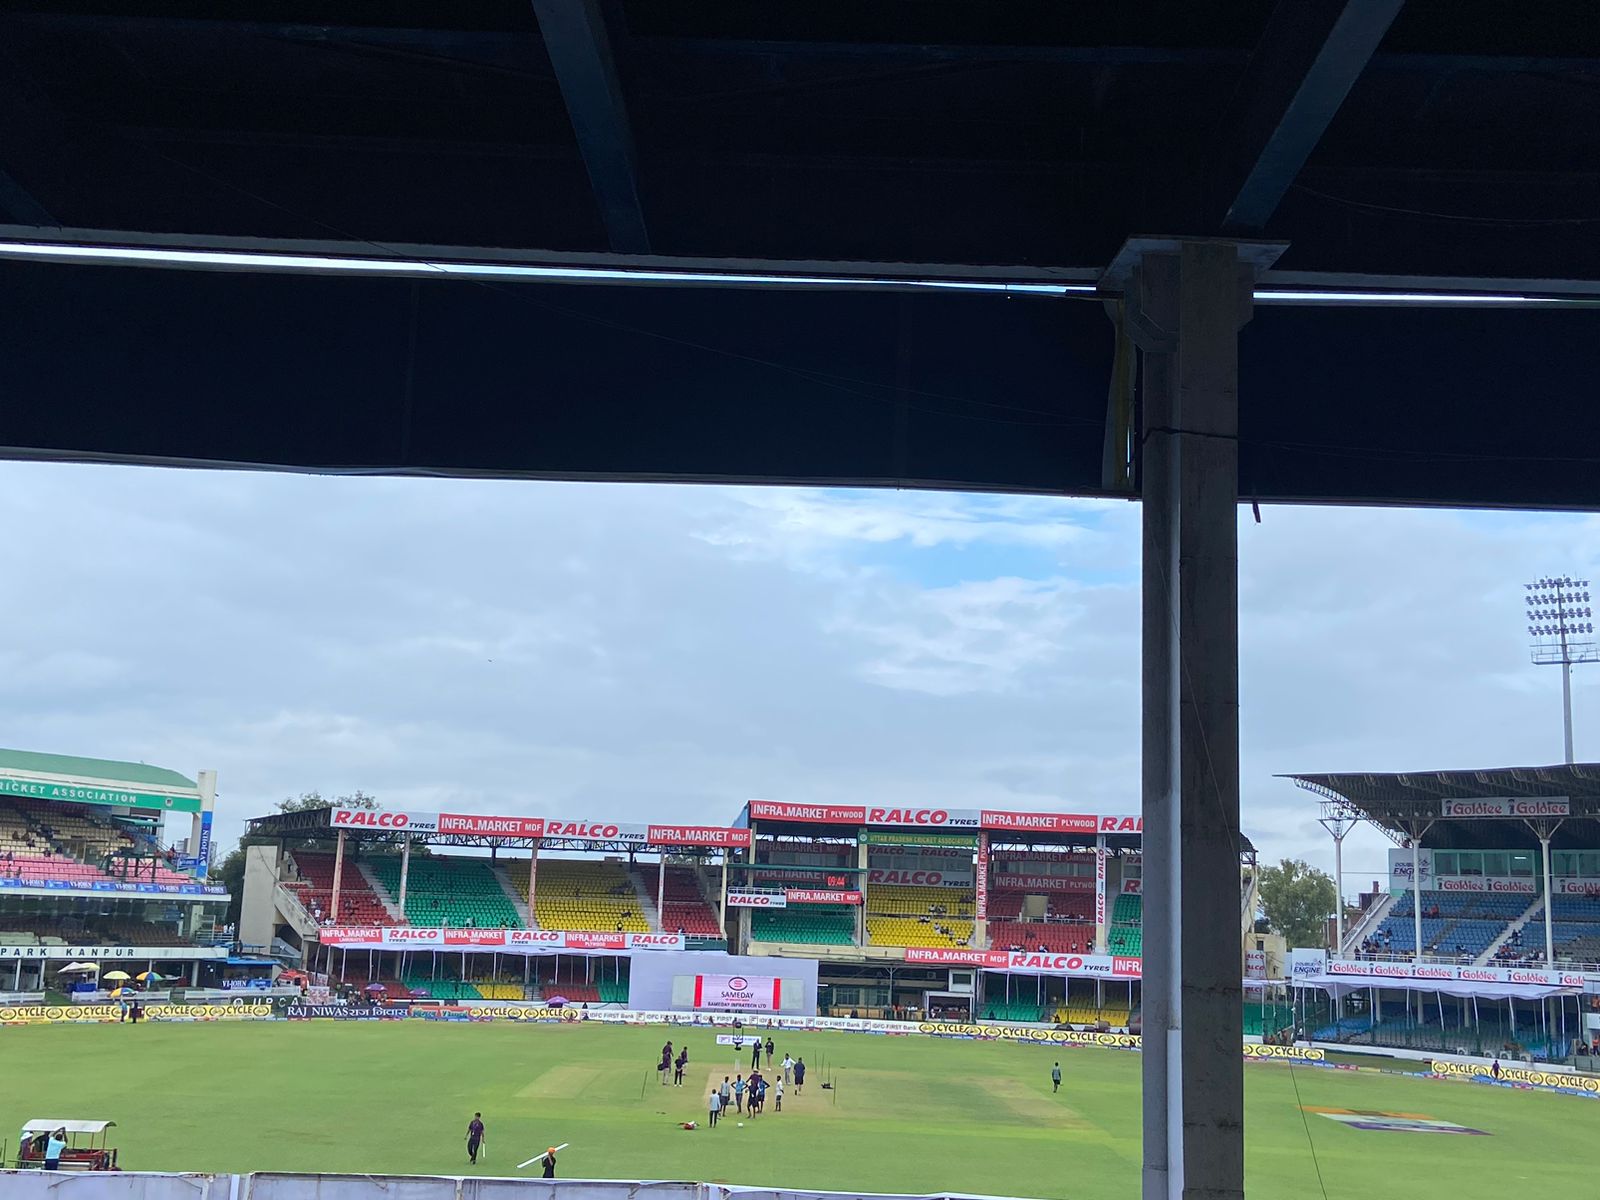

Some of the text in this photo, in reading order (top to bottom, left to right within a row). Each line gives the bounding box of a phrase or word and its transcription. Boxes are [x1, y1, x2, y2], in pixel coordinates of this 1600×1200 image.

[52, 788, 137, 803] ASSOCIATION
[753, 803, 864, 819] INFRA.MARKET PLYWOOD
[1453, 801, 1567, 815] Goldiee Goldiee
[334, 810, 408, 828] RALCO
[869, 808, 978, 826] RALCO TYRES
[983, 814, 1095, 828] INFRA.MARKET PLYWOOD
[441, 817, 542, 832] INFRA.MARKET MDF
[546, 821, 646, 840] RALCO TYRES
[650, 829, 749, 843] INFRA.MARKET MDF
[868, 869, 943, 885] RALCO
[995, 876, 1067, 889] INFRA.MARKET
[1443, 879, 1534, 892] Goldiee Goldiee
[729, 895, 770, 905] RALCO
[788, 891, 845, 901] INFRA.MARKET
[321, 928, 381, 938] INFRA.MARKET
[389, 930, 438, 939] RALCO
[445, 930, 503, 939] INFRA.MARKET
[511, 932, 559, 941] RALCO
[566, 933, 624, 943] INFRA.MARKET
[632, 935, 679, 945] RALCO
[0, 948, 134, 957] PARK KANPUR
[907, 949, 1008, 963] INFRA.MARKET MDF
[1011, 955, 1083, 970] RALCO
[1114, 959, 1142, 972] INFR
[1333, 962, 1368, 974] Goldiee
[1374, 964, 1409, 976] Goldiee
[1416, 966, 1453, 978] Goldiee
[1462, 969, 1497, 980] Goldiee
[1512, 971, 1549, 983] Goldiee
[222, 979, 247, 988] VI-JOHN
[721, 991, 754, 999] SAMEDAY
[18, 1007, 46, 1017] CYCLE
[83, 1006, 110, 1016] CYCLE
[163, 1006, 190, 1015] CYCLE
[226, 1005, 252, 1015] CYCLE
[287, 1006, 348, 1017] RAJ NIWAS
[484, 1007, 508, 1016] CYCLE
[539, 1008, 563, 1017] CYCLE
[937, 1024, 965, 1033] CYCLE
[1002, 1027, 1030, 1037] CYCLE
[1069, 1032, 1097, 1042] CYCLE
[1275, 1046, 1304, 1057] CYCLE
[1449, 1063, 1473, 1074] CYCLE
[1505, 1068, 1528, 1080] CYCLE
[1560, 1075, 1583, 1088] CYCLE
